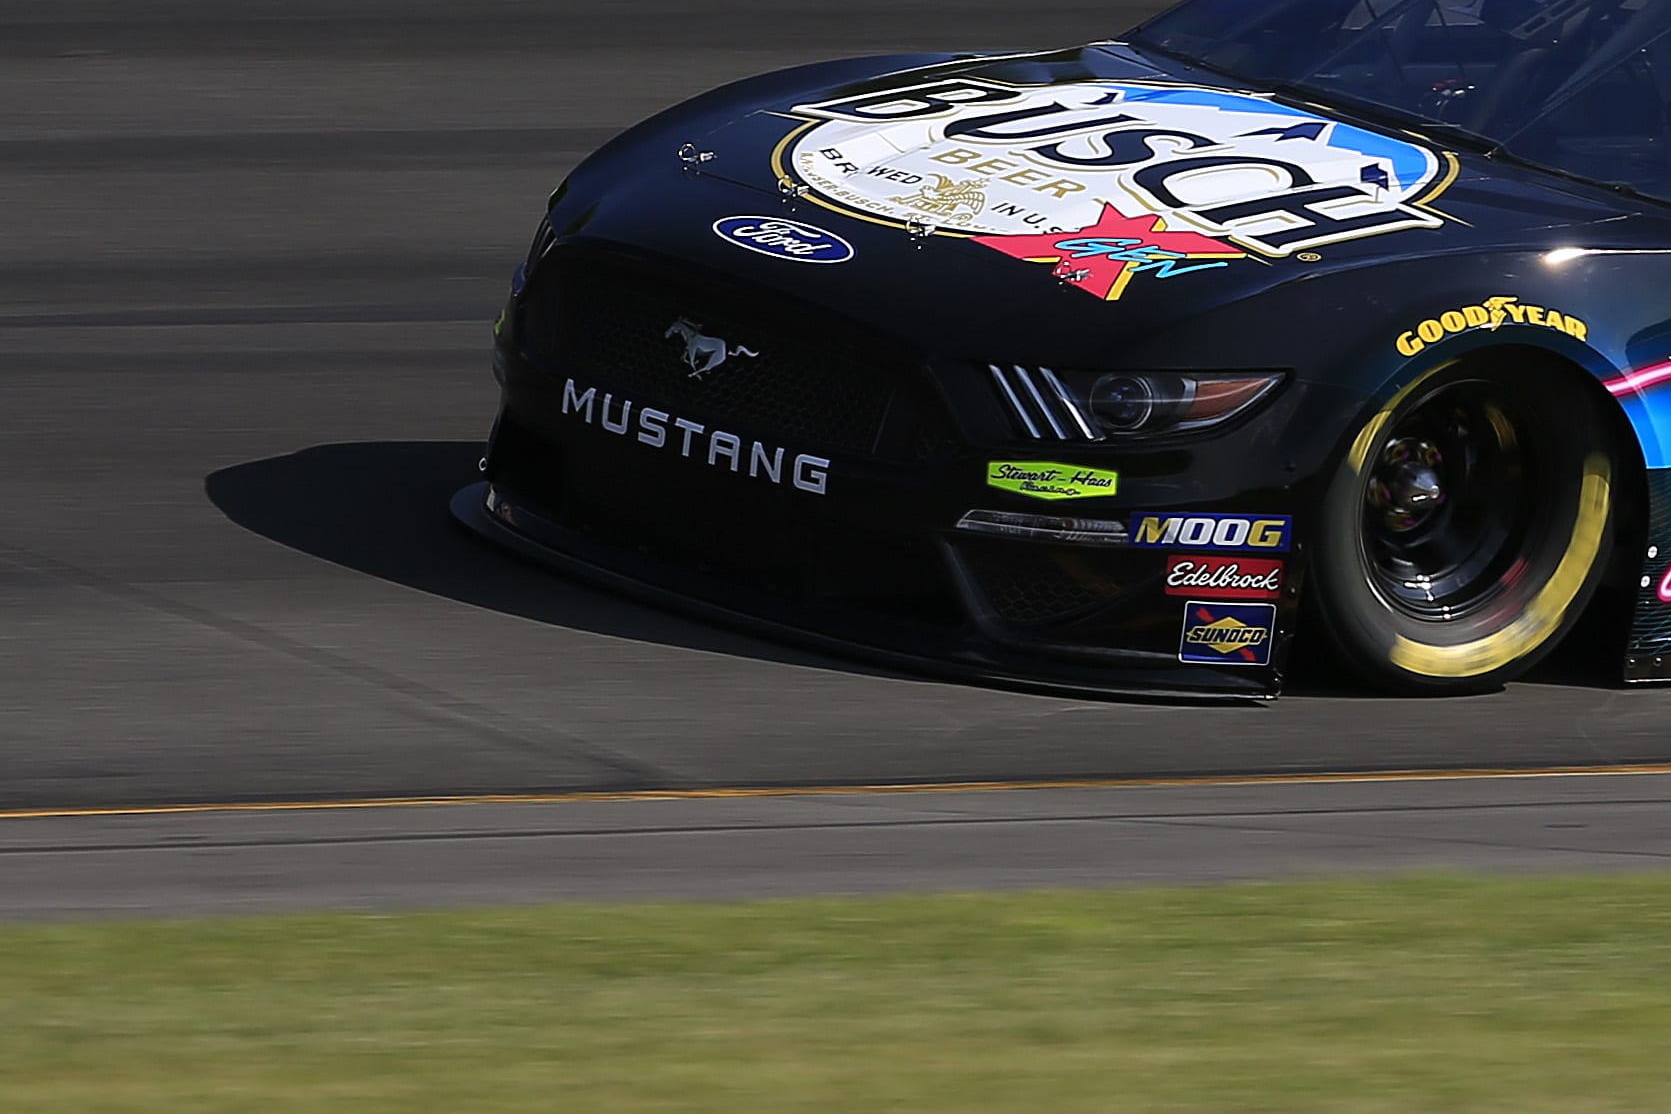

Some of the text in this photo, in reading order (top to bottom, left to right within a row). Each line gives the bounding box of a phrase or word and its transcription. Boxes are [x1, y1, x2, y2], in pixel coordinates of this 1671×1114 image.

[791, 78, 1443, 256] BUSCH
[819, 147, 922, 185] BRWED
[991, 202, 1024, 217] IN
[929, 148, 1087, 199] BEER
[732, 220, 834, 256] Ford
[1054, 237, 1229, 278] GEN
[1396, 297, 1588, 357] GOODYEAR
[561, 378, 831, 495] MUSTANG
[1134, 516, 1287, 547] MOOG
[1167, 561, 1281, 591] Edelbrock
[1186, 625, 1269, 645] SUNOCO
